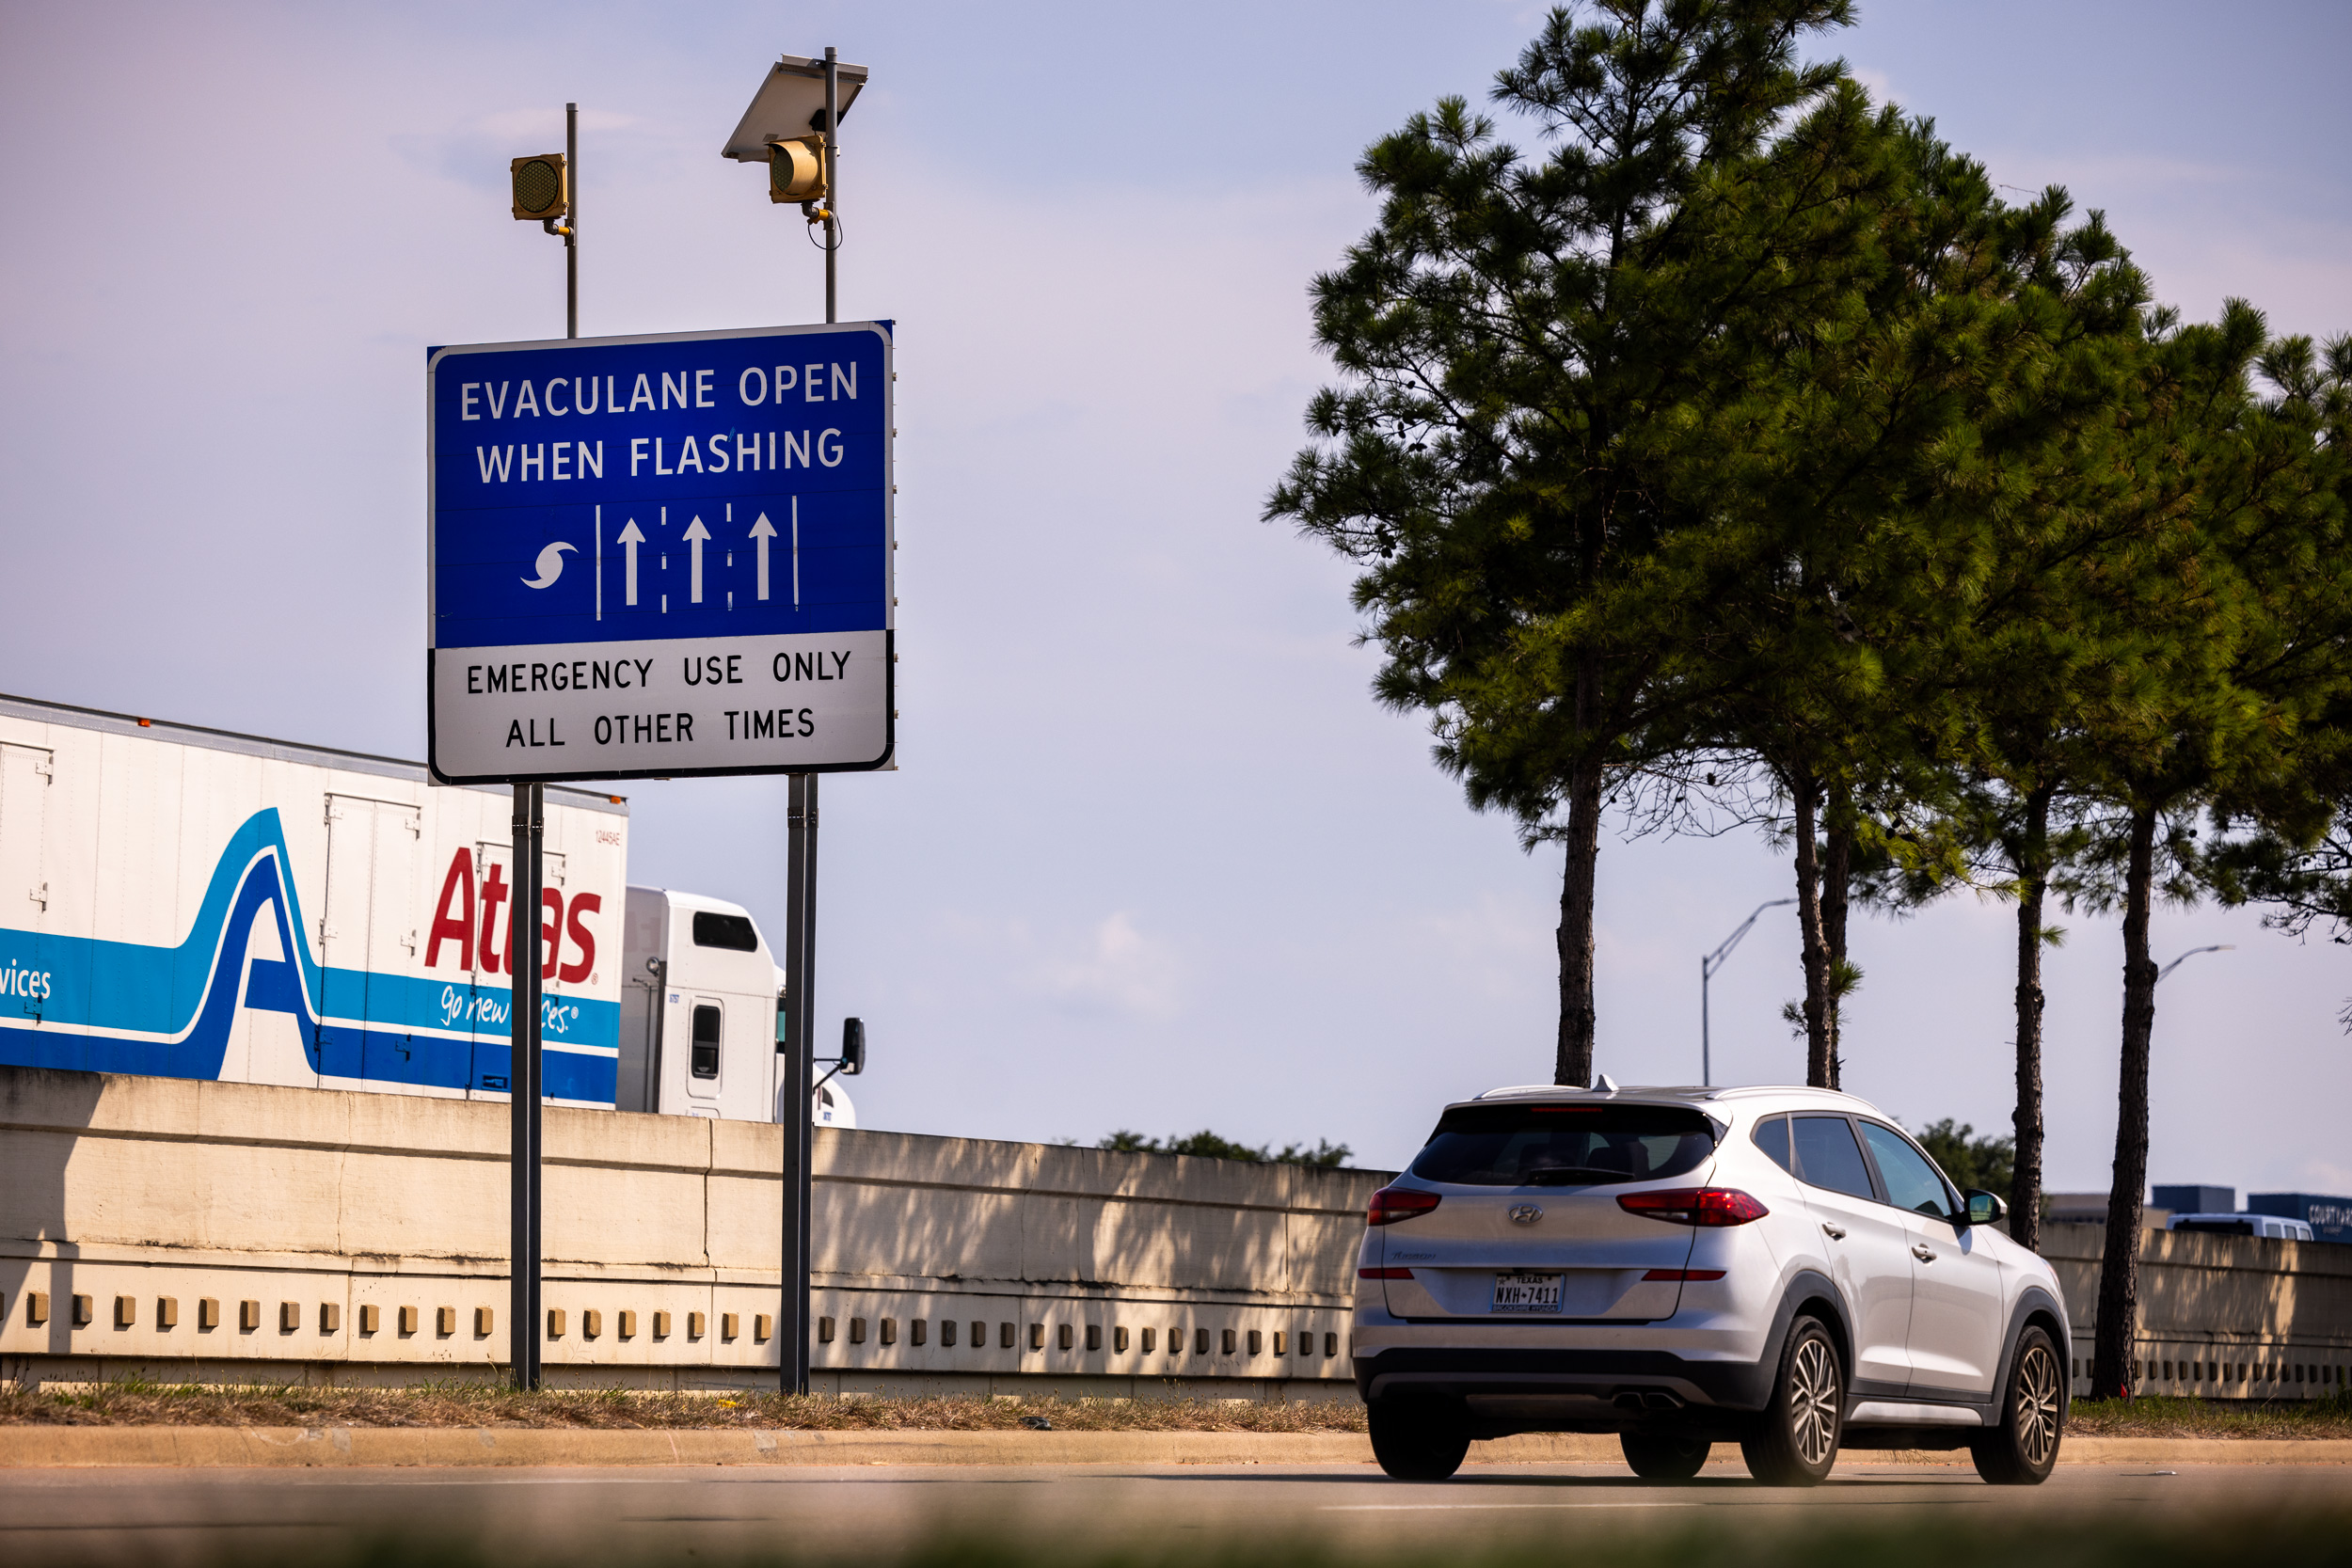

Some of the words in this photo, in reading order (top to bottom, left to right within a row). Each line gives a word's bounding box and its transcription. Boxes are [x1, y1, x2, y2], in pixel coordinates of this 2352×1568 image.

[462, 369, 715, 421] EVACULANE
[739, 361, 857, 406] OPEN
[476, 440, 603, 483] WHEN
[630, 428, 844, 477] FLASHING
[468, 658, 654, 694] EMERGENCY
[684, 655, 743, 687] USE
[772, 650, 851, 683] ONLY
[505, 717, 565, 748] ALL
[594, 712, 693, 746] OTHER
[723, 707, 815, 740] TIMES
[424, 847, 602, 984] Atas
[440, 984, 463, 1027] go
[465, 996, 510, 1024] new
[1516, 1276, 1544, 1285] TEXAS
